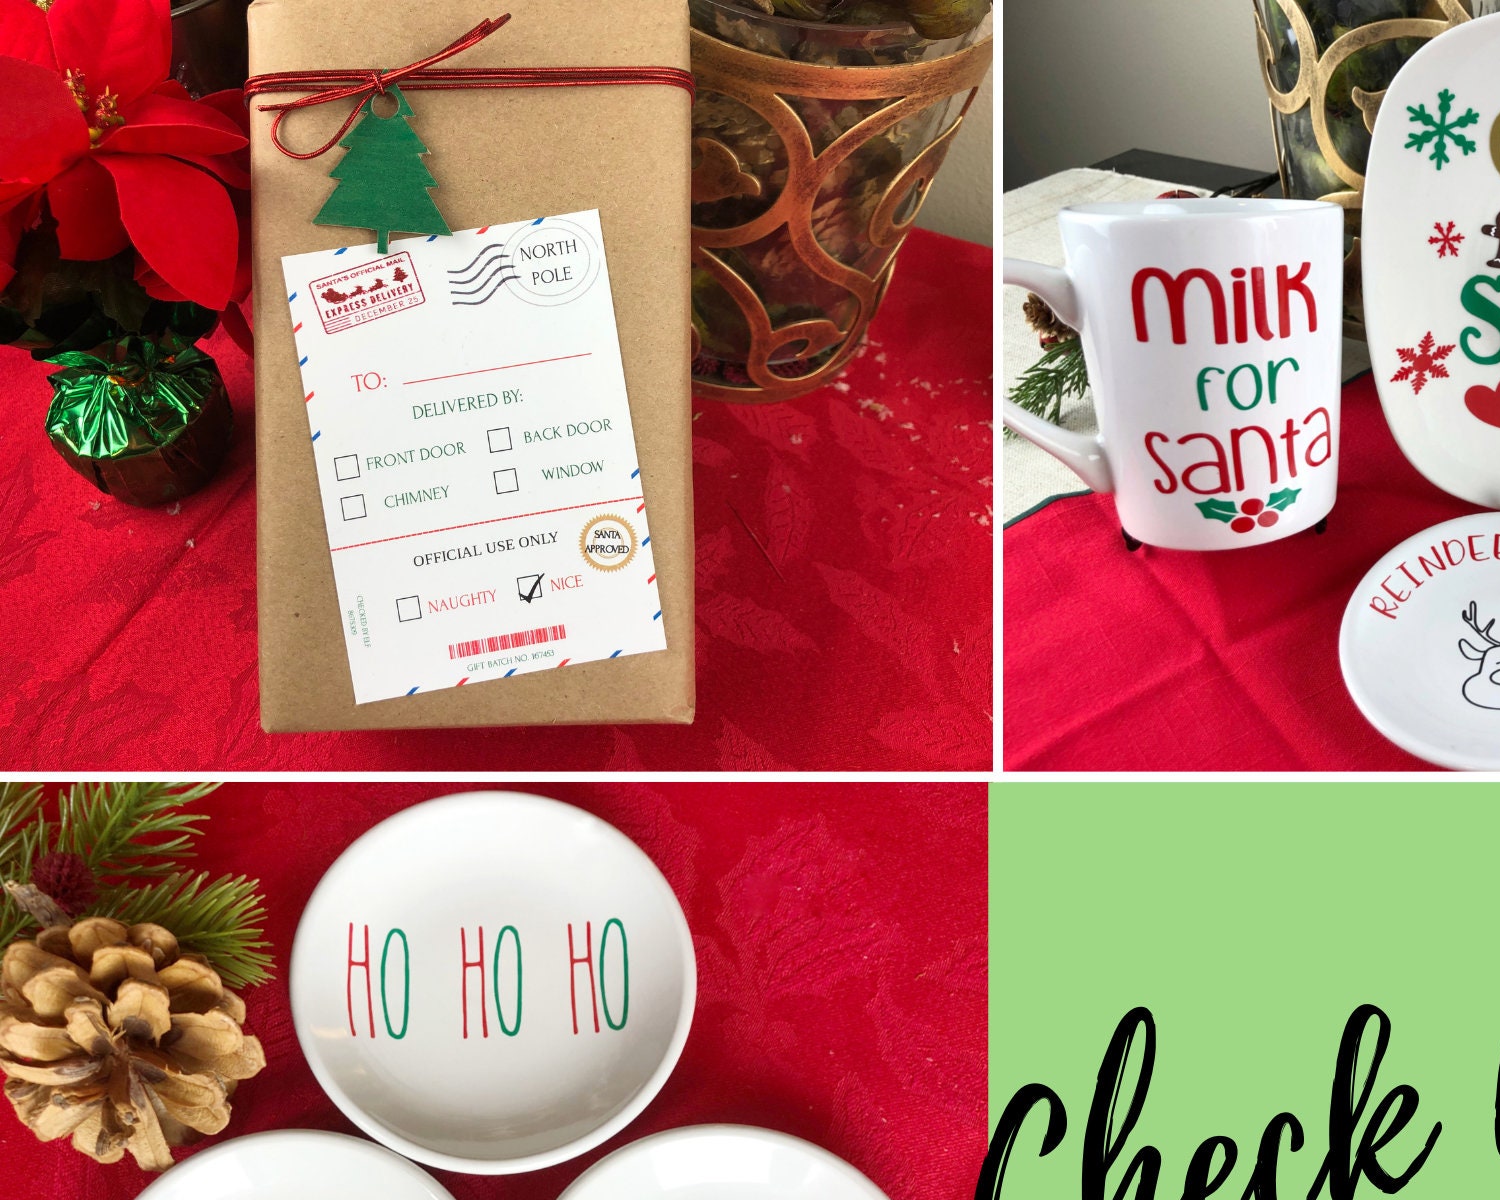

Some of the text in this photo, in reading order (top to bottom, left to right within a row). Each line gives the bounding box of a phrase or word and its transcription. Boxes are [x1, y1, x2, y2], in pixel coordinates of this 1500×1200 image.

[520, 240, 577, 262] NORTH
[350, 264, 385, 278] OFFICIAL
[386, 258, 405, 267] MAIL
[532, 267, 573, 286] POLE
[325, 283, 414, 318] EXPRESS DELIVERY
[355, 296, 419, 322] DECEMBER 25
[351, 372, 388, 393] TO:
[1197, 357, 1300, 411] for
[412, 389, 524, 420] DELIVERED BY:
[524, 418, 613, 444] BACK DOOR
[366, 441, 466, 471] FRONT DOOR
[1144, 406, 1332, 495] santa
[542, 460, 605, 481] WINDOW
[384, 485, 450, 509] CHIMNEY
[594, 529, 621, 539] SANTA
[413, 531, 559, 567] OFFICIAL USE ONLY
[584, 544, 630, 554] APPROVED
[428, 574, 584, 614] NAUGHTY NICE
[467, 662, 485, 672] GIFT
[488, 656, 512, 668] BATCH
[347, 917, 629, 1039] HO HO HO
